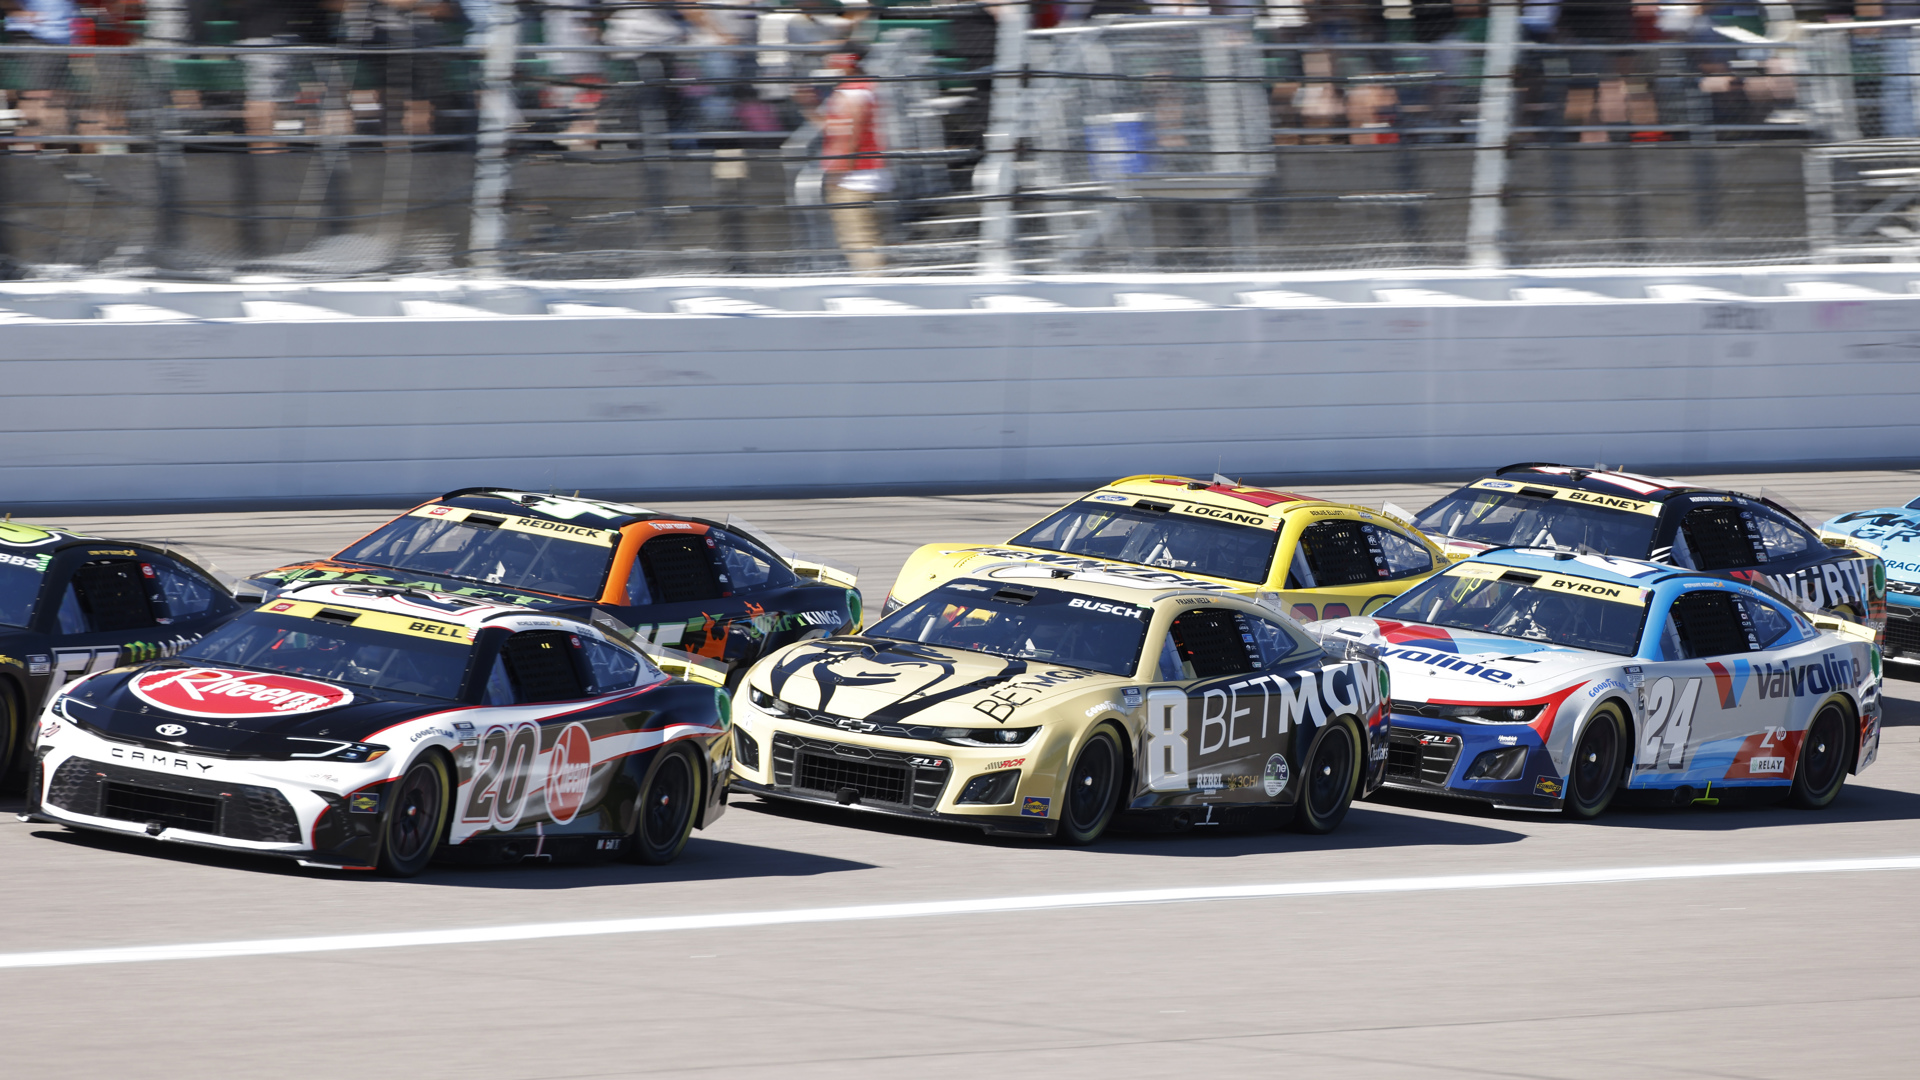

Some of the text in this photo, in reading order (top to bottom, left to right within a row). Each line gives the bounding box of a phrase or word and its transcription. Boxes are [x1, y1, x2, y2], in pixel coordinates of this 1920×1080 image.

[1569, 491, 1646, 511] BLANEY
[1184, 505, 1264, 526] LOGANO
[516, 518, 601, 538] REDDICK
[1551, 579, 1621, 597] BYRON
[1766, 558, 1869, 611] WÜRTH
[1068, 598, 1142, 619] BUSCH
[408, 621, 462, 638] BELL
[1753, 653, 1862, 699] Valvoline
[140, 667, 331, 712] Rheem
[1588, 678, 1628, 698] GOODYEAR
[1200, 661, 1380, 755] BETMGM
[1636, 676, 1702, 770] 24
[410, 726, 455, 742] GOODYEAR
[1147, 687, 1190, 792] 8
[1423, 735, 1453, 743] ZL1
[112, 747, 214, 773] CAMRY
[547, 728, 590, 806] Rheem
[910, 757, 943, 766] ZL1
[1000, 758, 1026, 768] RCR
[1758, 760, 1783, 770] RELAY
[461, 722, 541, 830] 20
[1197, 773, 1223, 788] REBEL
[1024, 803, 1049, 811] SUNOCO
